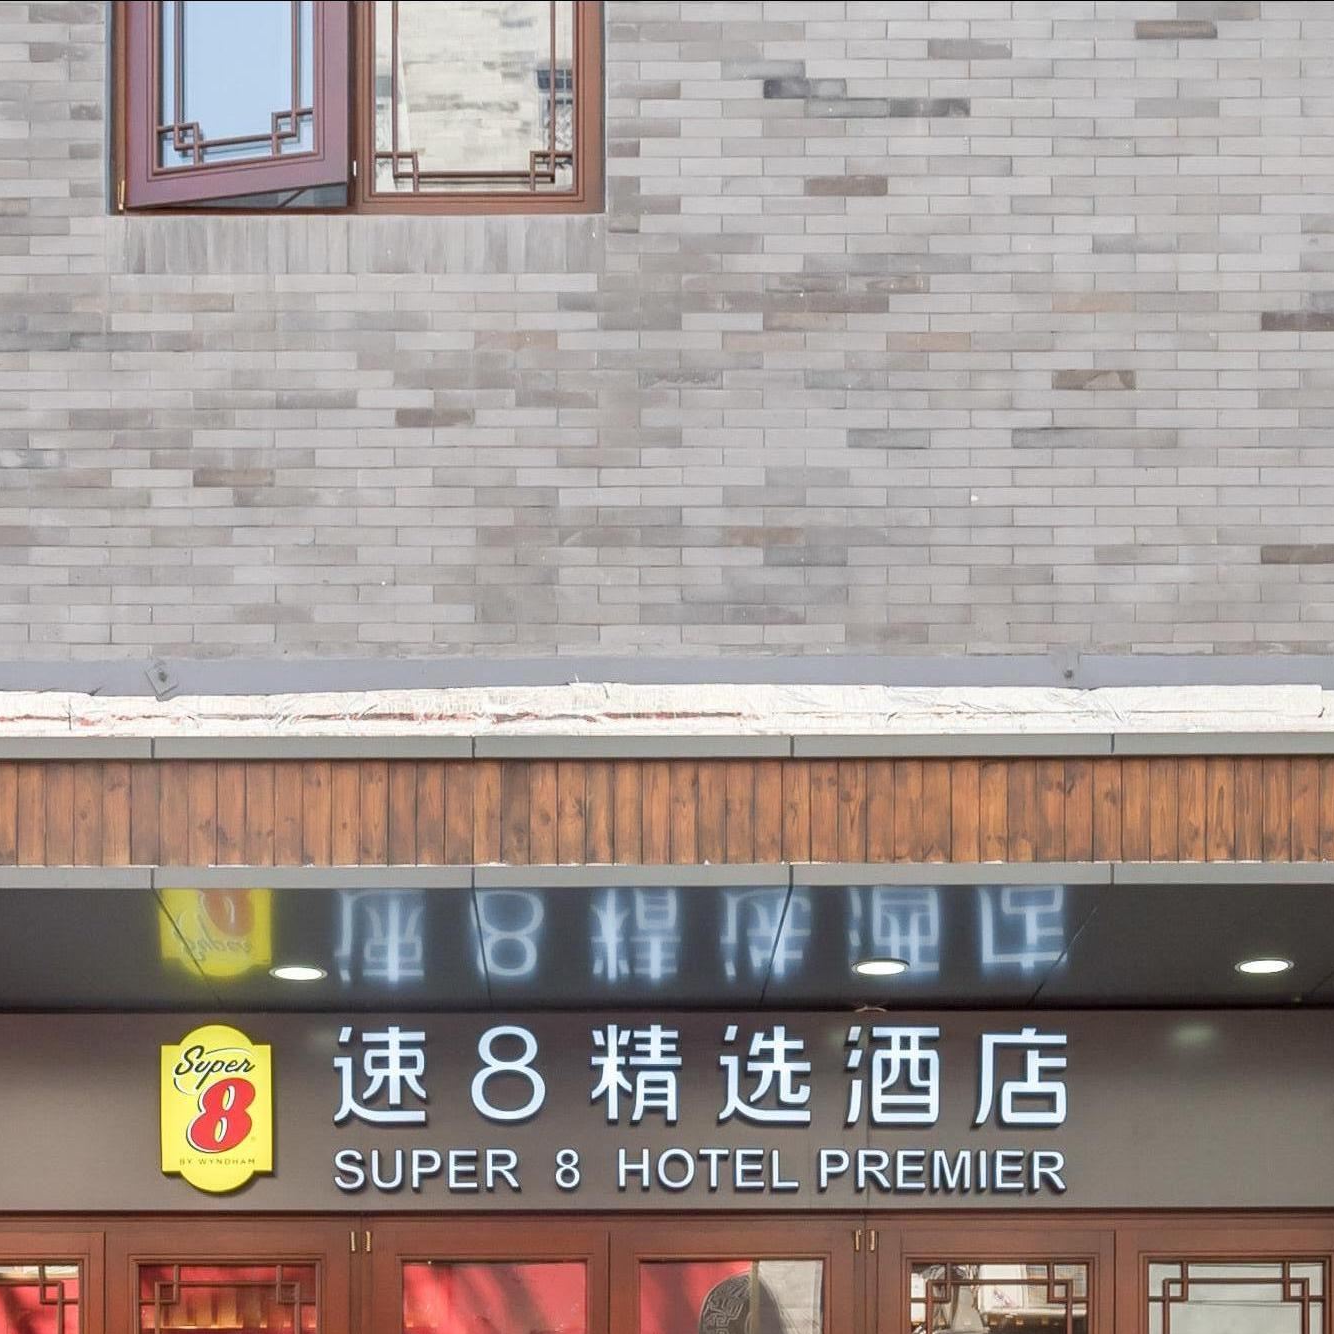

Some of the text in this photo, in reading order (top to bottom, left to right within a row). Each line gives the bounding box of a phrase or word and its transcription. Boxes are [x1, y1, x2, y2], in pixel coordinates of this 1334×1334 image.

[174, 1045, 256, 1090] Super
[333, 1024, 1068, 1126] 速8精选酒店
[186, 1077, 256, 1154] 8
[179, 1158, 256, 1166] BY WYNDHAM
[333, 1148, 1067, 1191] SUPER 8 HOTEL PREMIER
